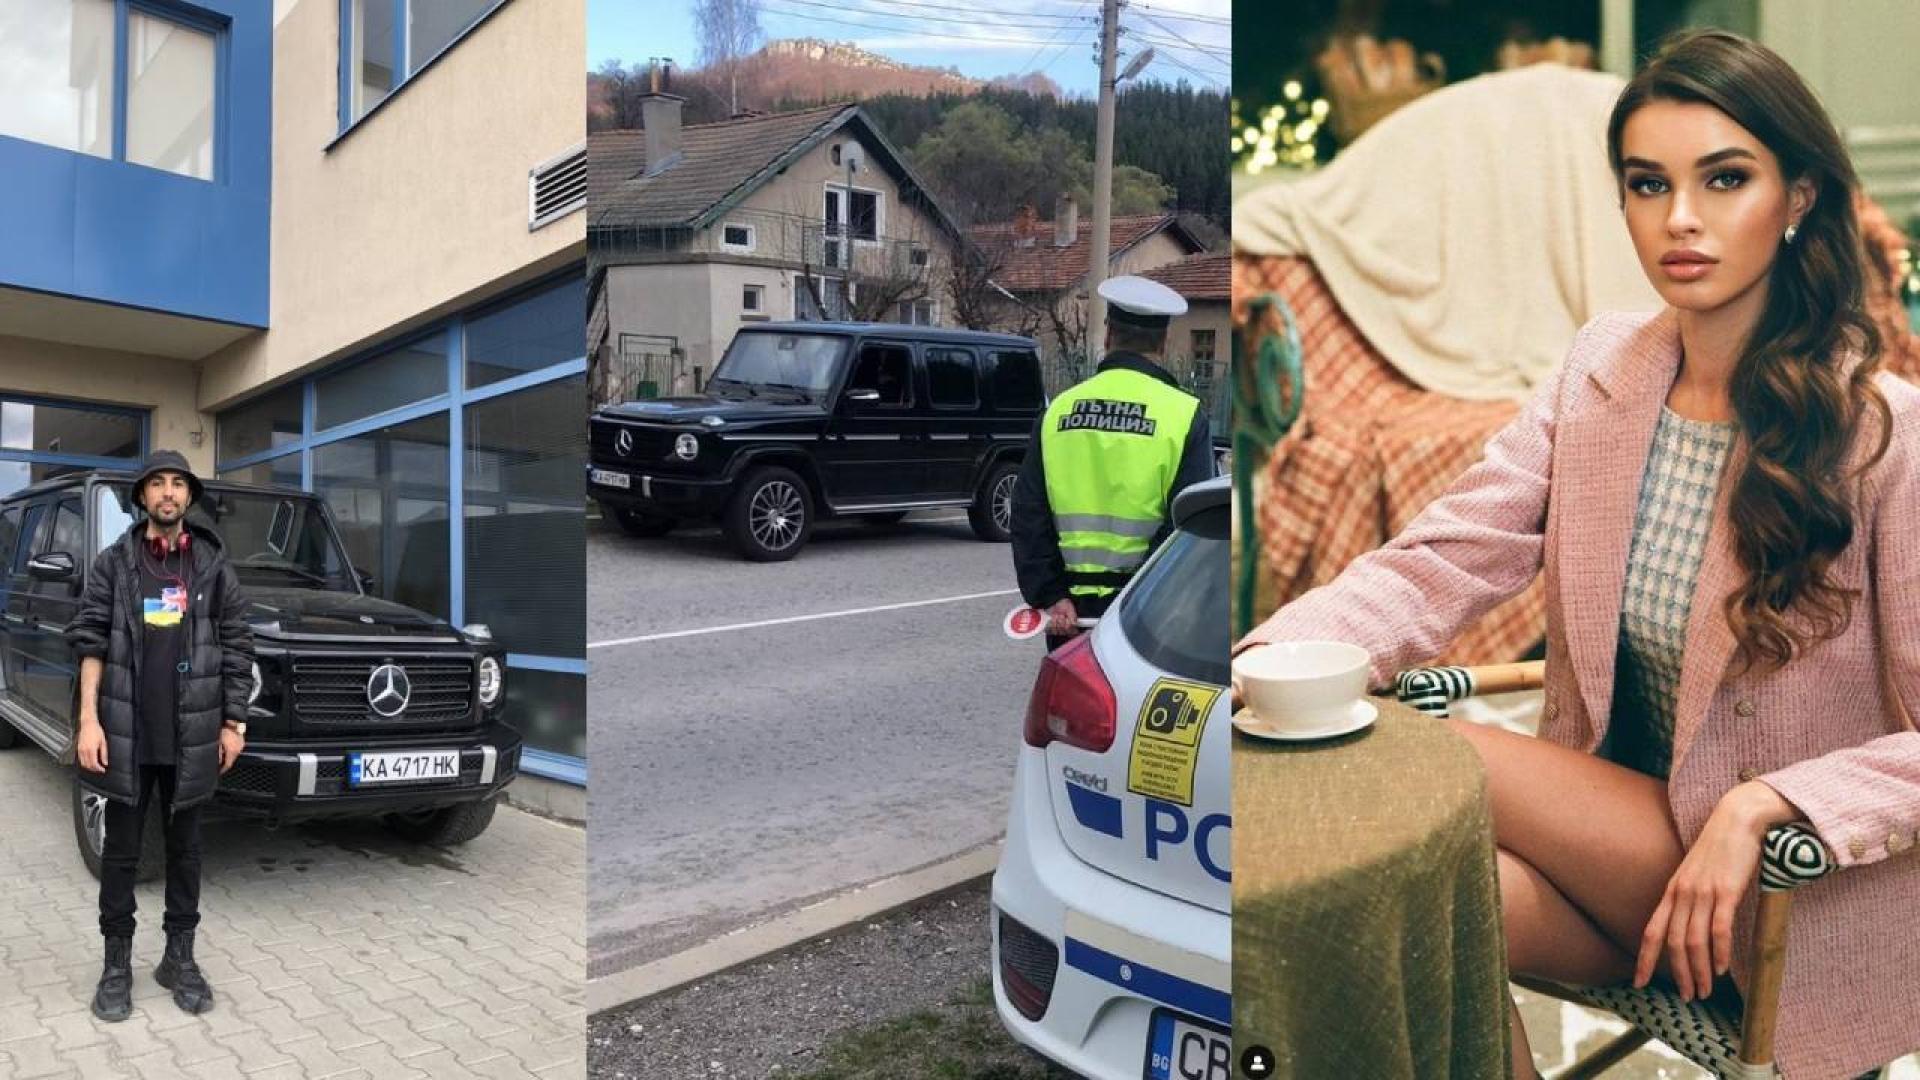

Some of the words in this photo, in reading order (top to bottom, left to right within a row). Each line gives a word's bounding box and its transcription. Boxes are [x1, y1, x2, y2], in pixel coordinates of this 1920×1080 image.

[1074, 399, 1143, 416] ПЪТНА
[1060, 413, 1154, 434] ПОЛИЦИЯ
[363, 758, 388, 778] KA
[392, 756, 430, 777] 4717
[434, 755, 455, 775] HK
[1151, 1053, 1170, 1072] BG
